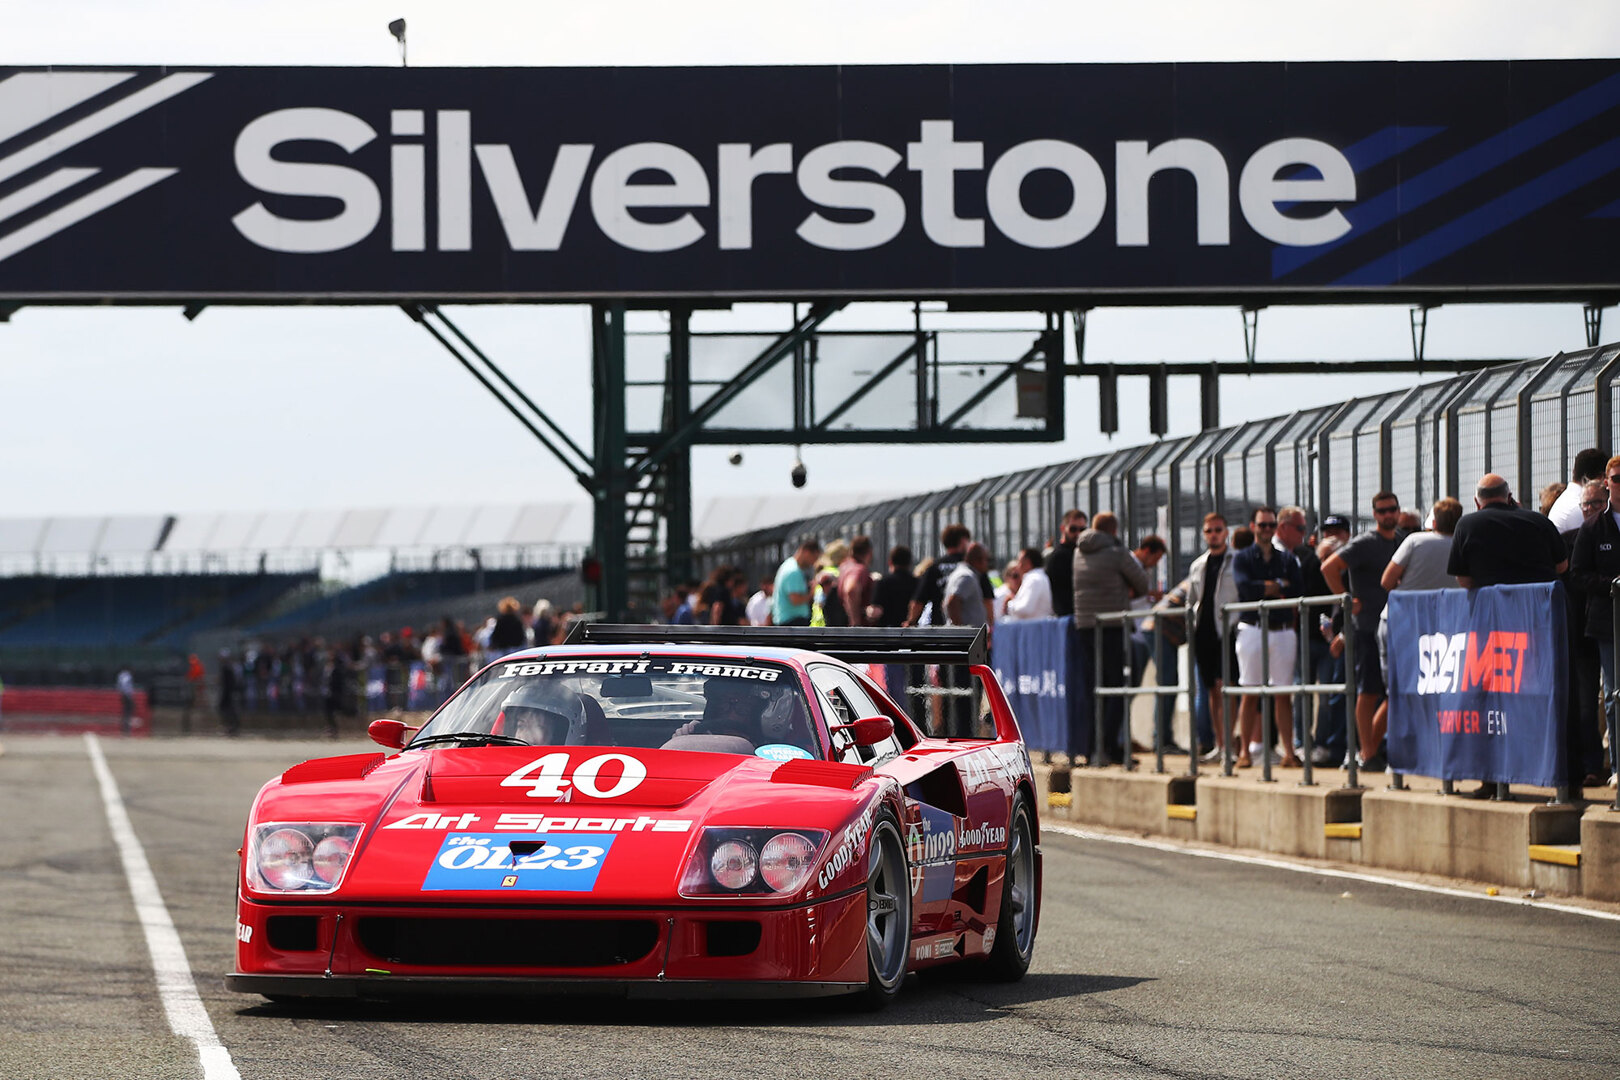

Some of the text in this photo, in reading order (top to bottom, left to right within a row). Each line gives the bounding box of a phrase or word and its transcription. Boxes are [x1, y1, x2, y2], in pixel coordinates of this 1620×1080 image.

[231, 107, 1357, 253] Silverstone
[500, 752, 648, 799] 40
[383, 813, 693, 833] Art Sports
[447, 835, 492, 846] the
[438, 845, 605, 871] 0123
